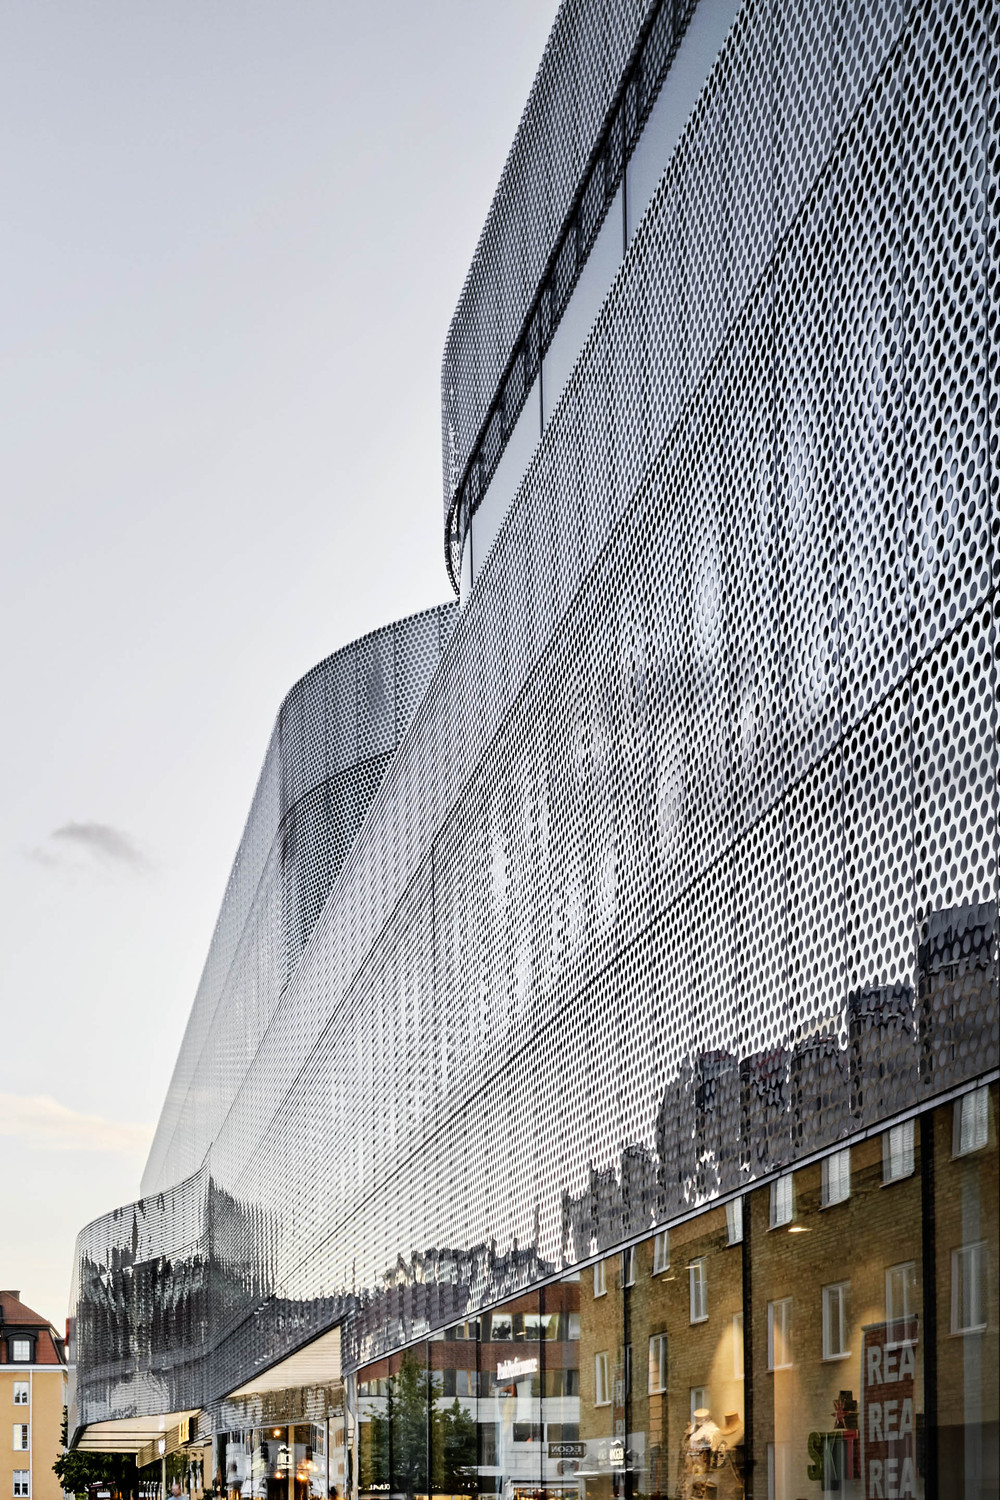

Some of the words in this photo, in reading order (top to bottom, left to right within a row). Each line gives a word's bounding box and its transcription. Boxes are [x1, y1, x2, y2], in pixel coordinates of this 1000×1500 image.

[867, 1343, 915, 1387] REA
[868, 1397, 914, 1443] REA
[869, 1457, 917, 1500] REA
